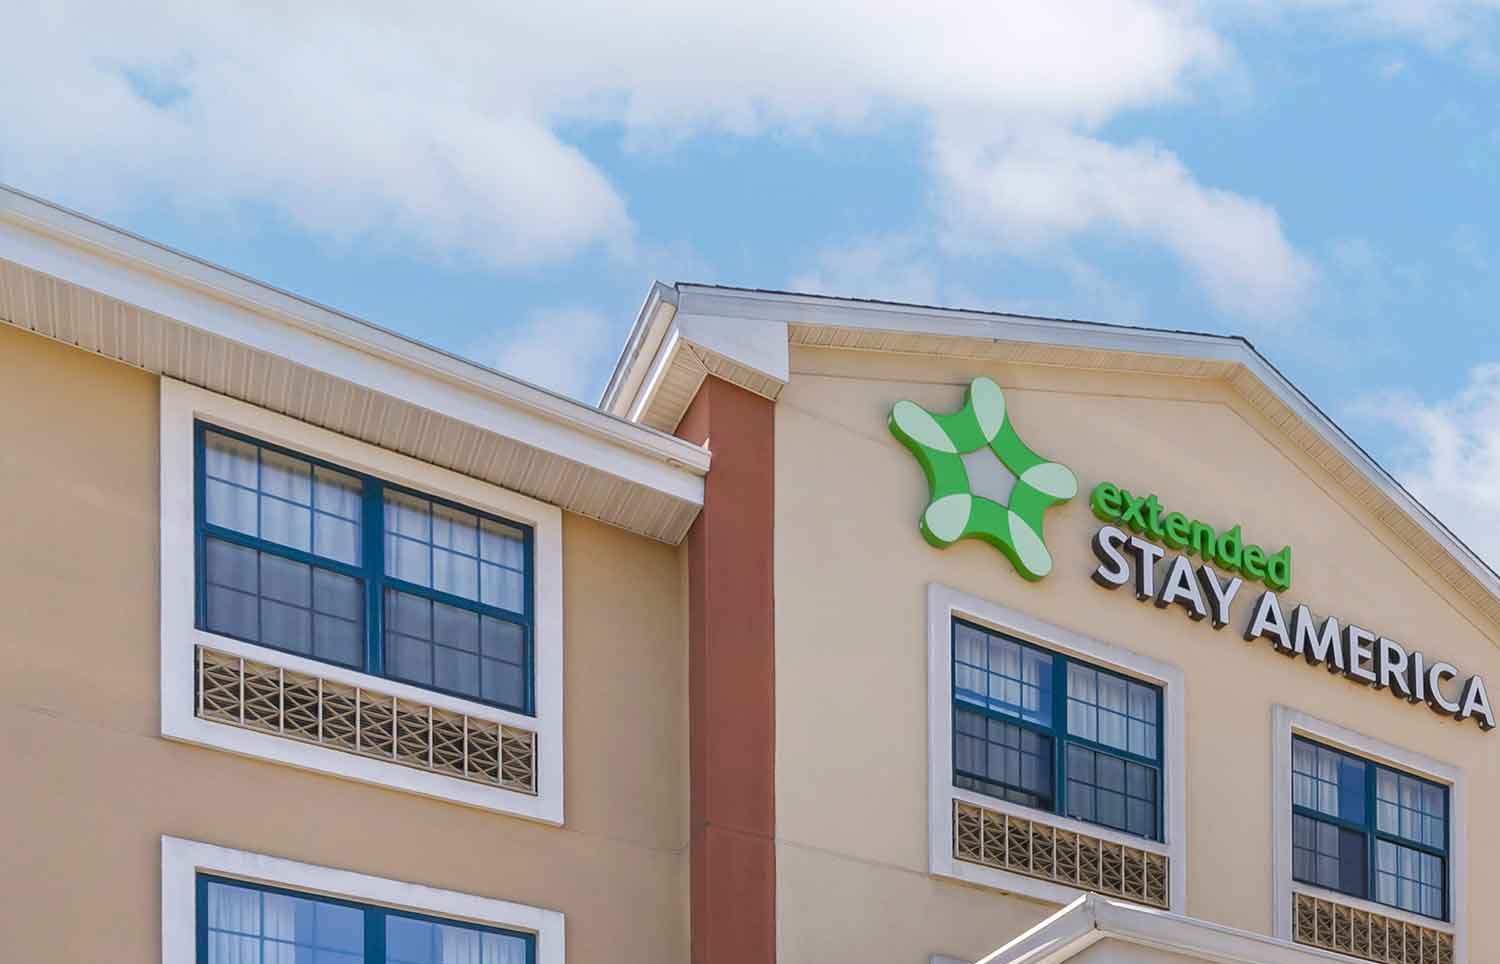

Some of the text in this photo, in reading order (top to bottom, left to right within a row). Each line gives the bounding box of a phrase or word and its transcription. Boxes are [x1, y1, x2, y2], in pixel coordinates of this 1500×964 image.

[1090, 481, 1292, 592] extended
[1091, 526, 1497, 731] STAY AMERICA
